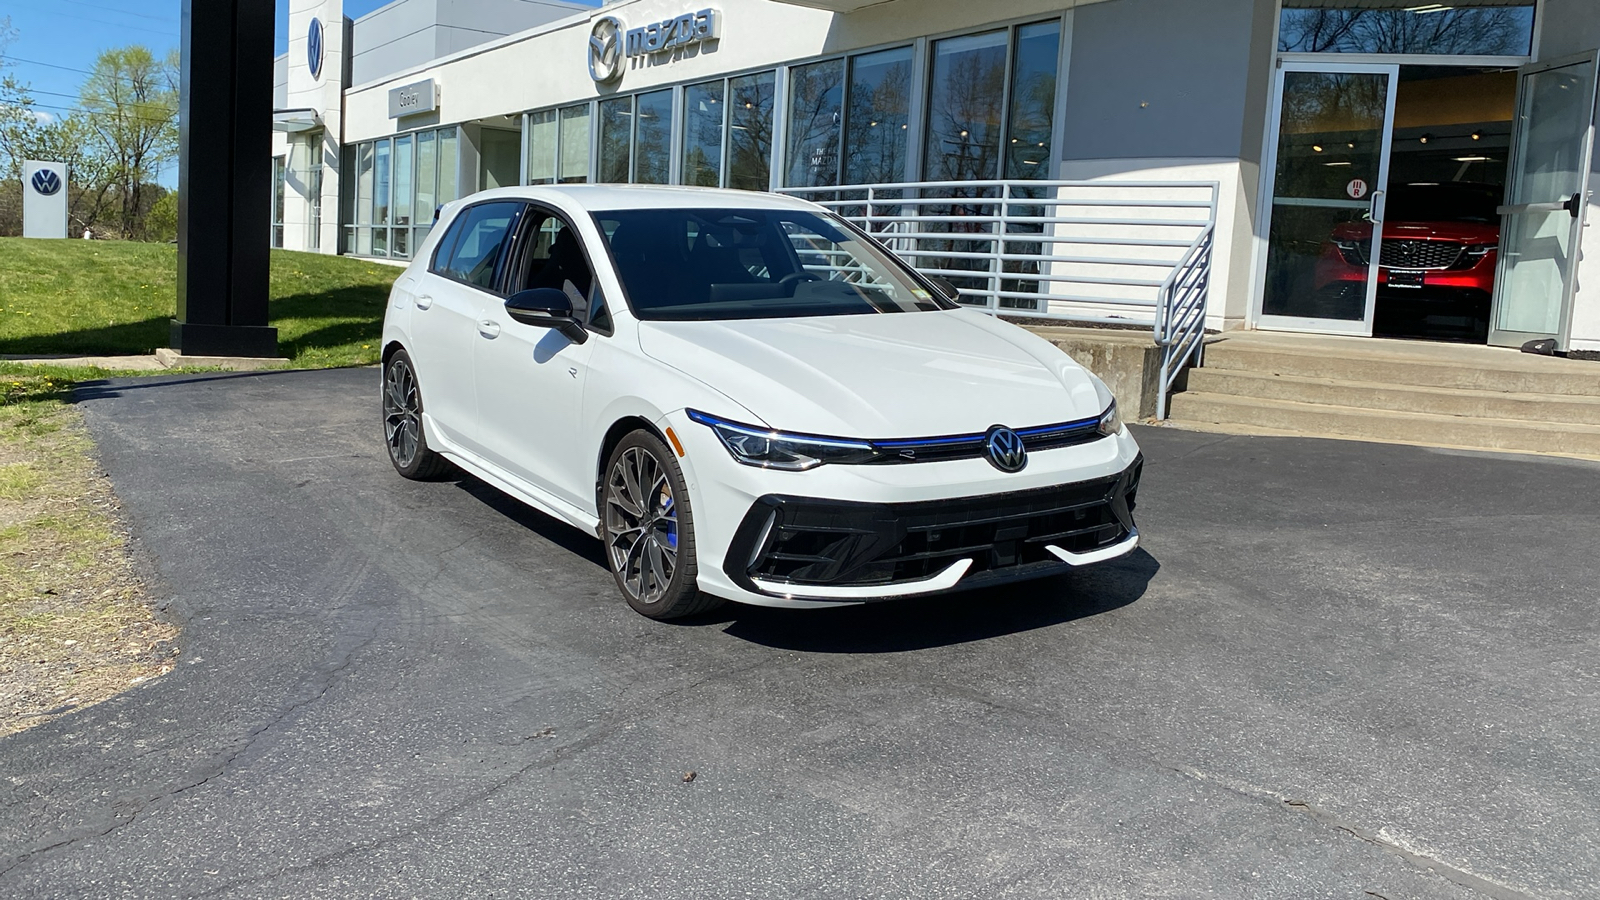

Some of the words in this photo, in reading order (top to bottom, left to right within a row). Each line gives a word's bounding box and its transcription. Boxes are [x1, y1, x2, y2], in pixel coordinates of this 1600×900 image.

[626, 8, 718, 58] mazda
[32, 169, 61, 195] VW
[989, 428, 1025, 470] VW
